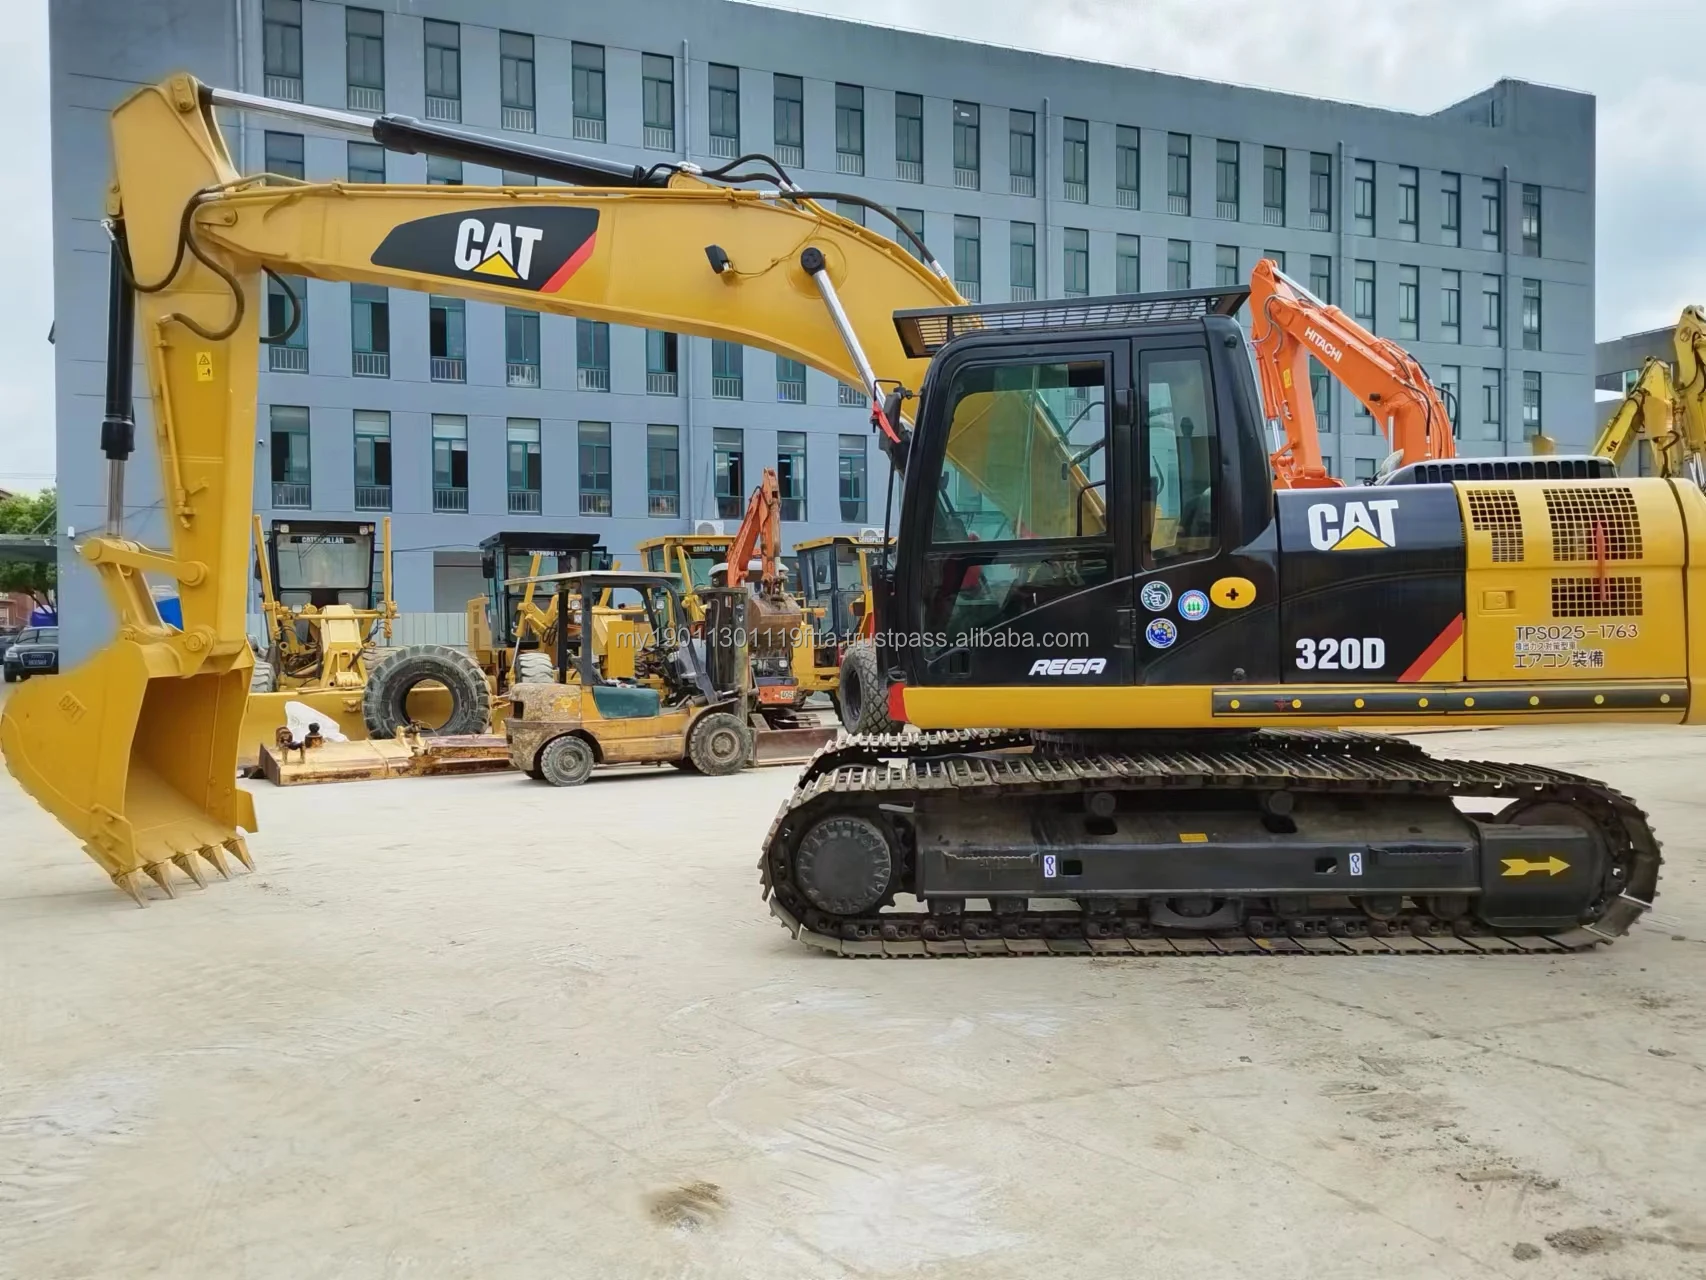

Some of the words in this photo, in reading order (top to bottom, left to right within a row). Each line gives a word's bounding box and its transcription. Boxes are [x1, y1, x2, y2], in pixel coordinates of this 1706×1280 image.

[454, 218, 543, 281] CAT
[1304, 325, 1343, 364] HITACHI
[1308, 499, 1399, 550] CAT
[1028, 658, 1107, 675] REGA
[1295, 637, 1386, 669] 320D
[1514, 651, 1604, 669] エアコン装備
